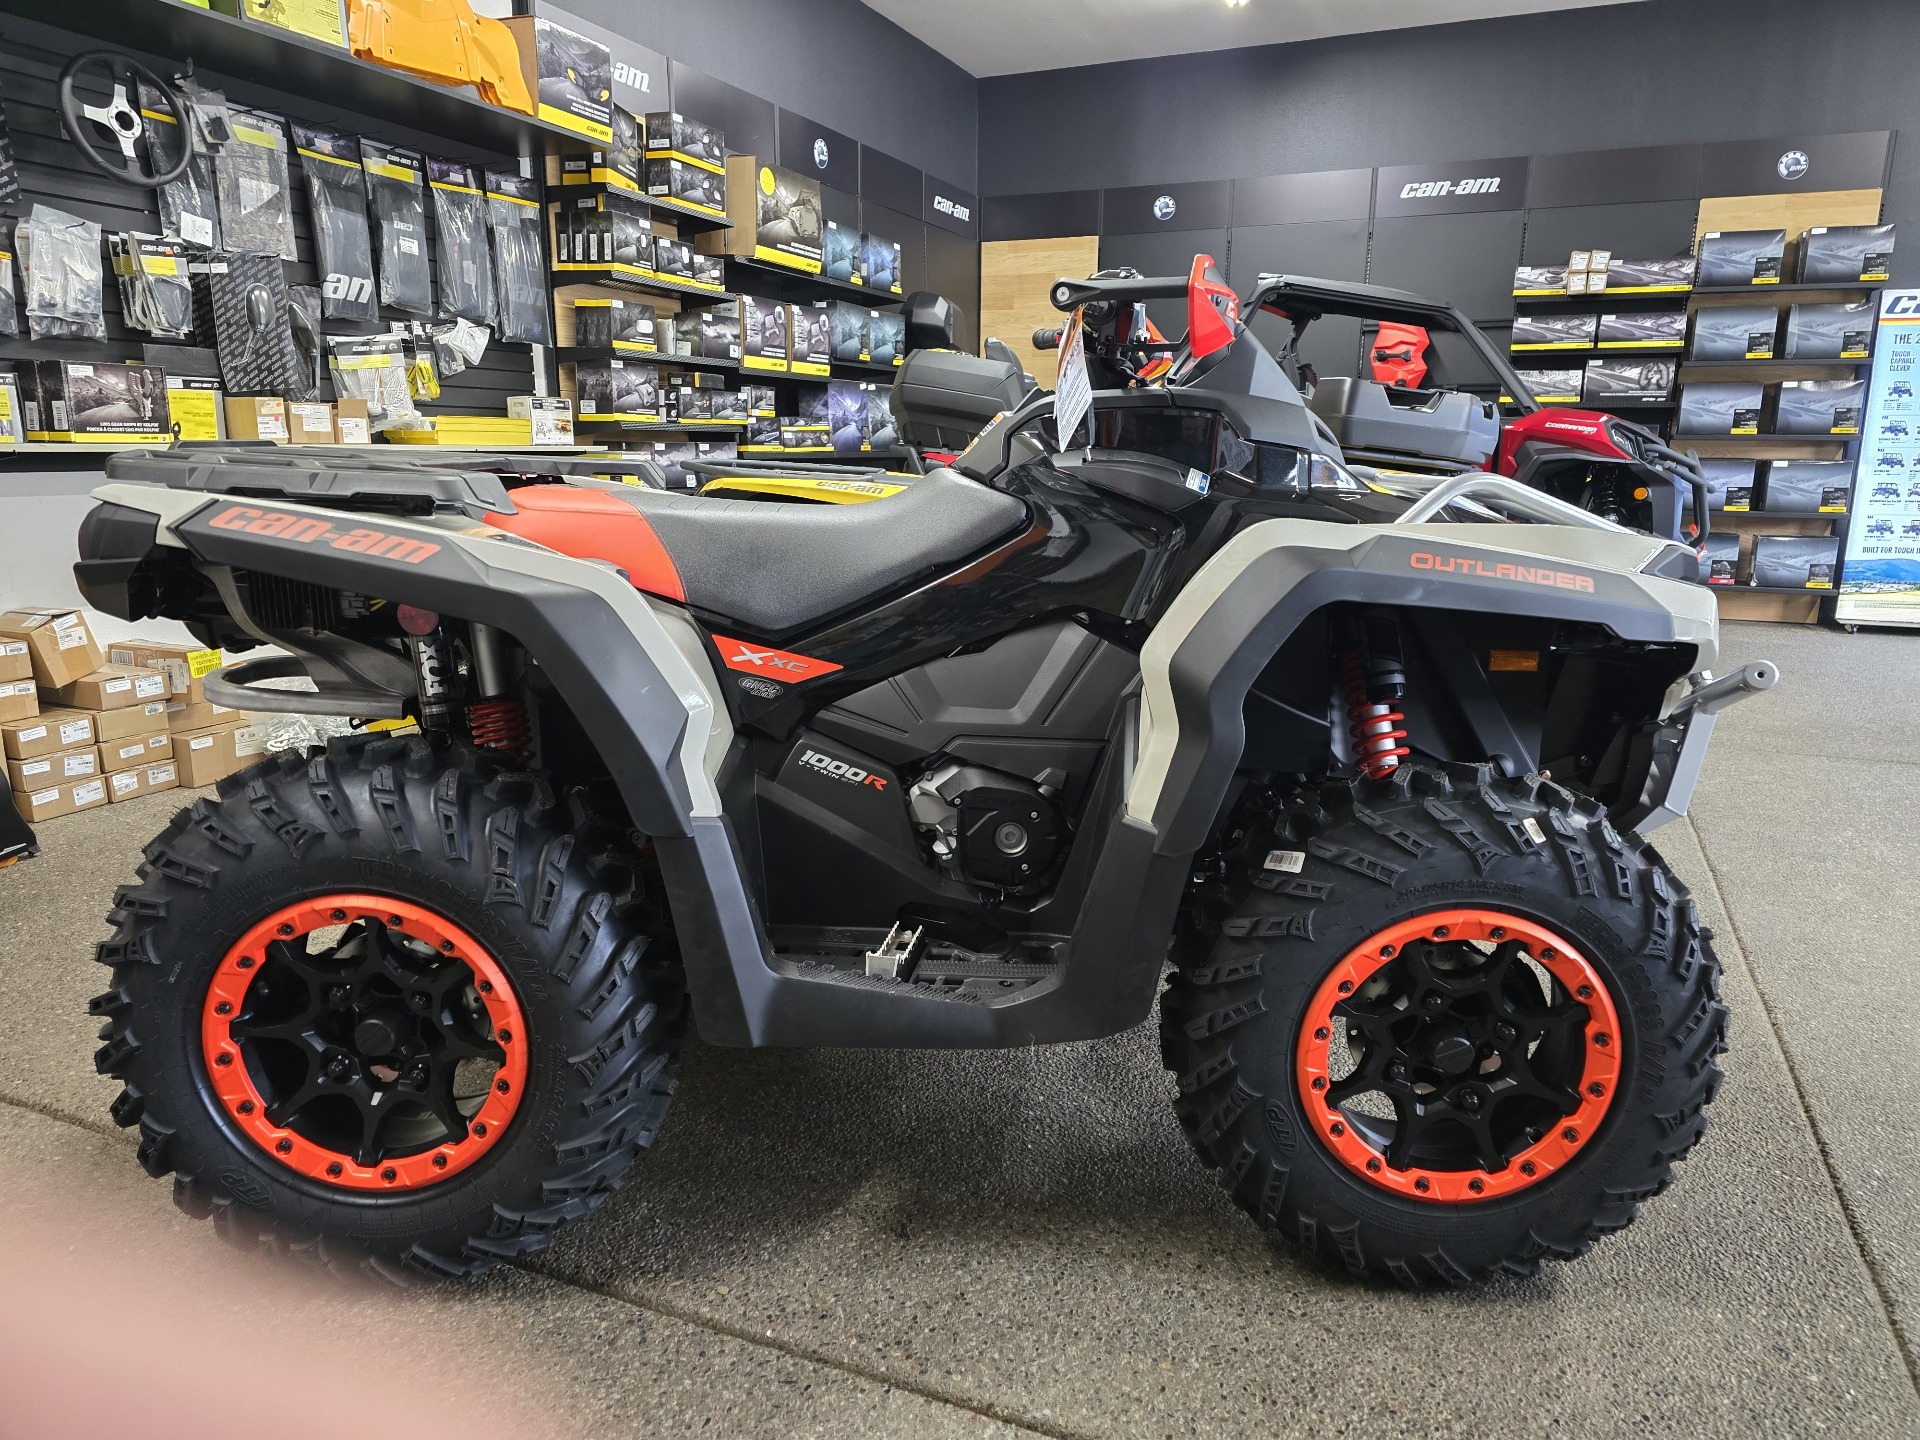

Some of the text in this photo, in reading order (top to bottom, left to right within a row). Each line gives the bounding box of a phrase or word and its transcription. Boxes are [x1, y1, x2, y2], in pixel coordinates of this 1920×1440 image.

[586, 125, 609, 137] can-am
[1400, 177, 1501, 198] can-am
[933, 195, 970, 222] can-am
[322, 272, 373, 304] an
[1885, 295, 1920, 314] C
[352, 344, 387, 352] can-am
[1894, 333, 1912, 344] THE
[1544, 422, 1598, 433] COMMANDER
[208, 506, 442, 564] can-am
[1862, 546, 1880, 554] BUILT
[1409, 552, 1596, 594] OUTLANDER
[418, 640, 452, 697] FOX
[741, 678, 781, 694] GNCC
[798, 760, 840, 779] V-TWIN
[800, 749, 888, 791] 1000R
